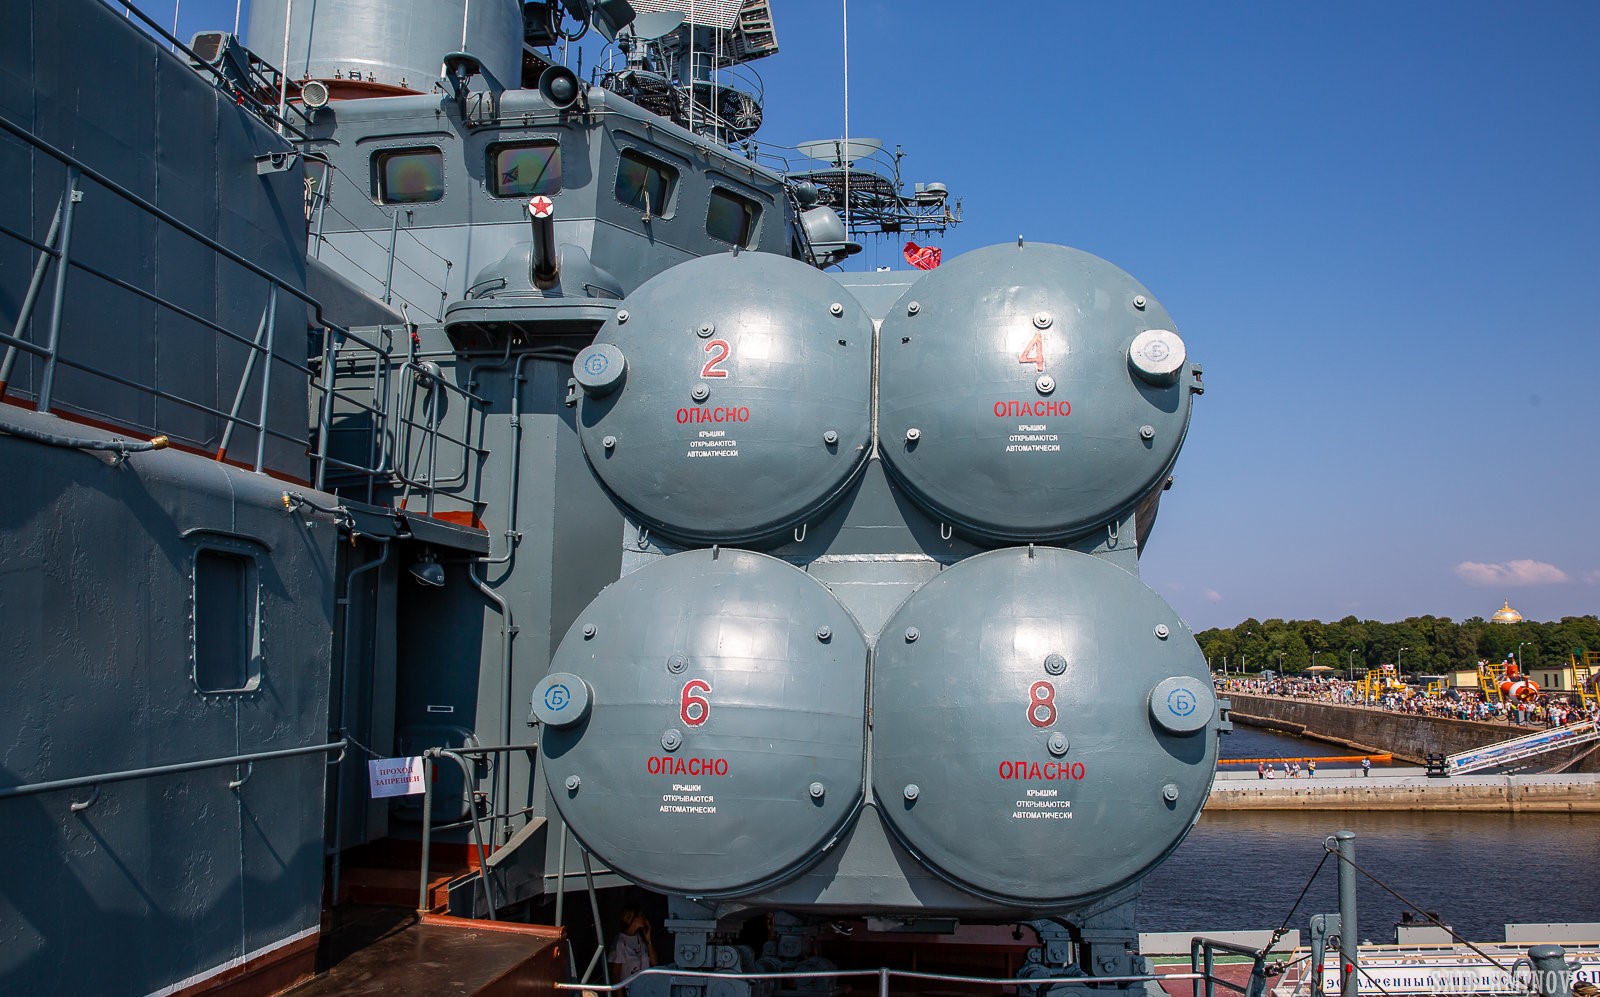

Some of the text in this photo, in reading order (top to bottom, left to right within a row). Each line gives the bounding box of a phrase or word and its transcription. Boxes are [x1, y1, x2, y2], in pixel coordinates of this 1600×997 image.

[1018, 331, 1044, 373] 4
[700, 339, 730, 378] 2
[993, 401, 1072, 418] ОПАСНО
[675, 406, 750, 424] ОПАСНО
[1018, 424, 1047, 432] КРЫШКИ
[698, 430, 725, 438] КРЫШКИ
[1008, 434, 1059, 442] ОТКРЫВАЮТСЯ
[690, 440, 737, 448] ОТКРЫВАЮТСЯ
[1005, 444, 1061, 452] АВТОМАТИЧЕСКИ
[686, 450, 739, 458] АВТОМАТИЧЕСКИ
[680, 678, 713, 728] 6
[1026, 679, 1058, 728] 8
[647, 756, 729, 776] ОПАСНО
[999, 761, 1085, 780] ОПАСНО
[380, 766, 413, 776] ПРОХОД
[375, 776, 420, 786] ЗАПРЕЩЕН
[672, 783, 702, 792] КРЫШКИ
[1026, 789, 1058, 797] КРЫШКИ
[662, 794, 714, 803] ОТКРЫВАЮТСЯ
[1016, 800, 1071, 808] ОТКРЫВАЮТСЯ
[659, 805, 717, 814] АВТОМАТИЧЕСКИ
[1012, 811, 1073, 820] АВТОМАТИЧЕСКИ
[1326, 974, 1435, 989] ЭАДРЕННЫЙ
